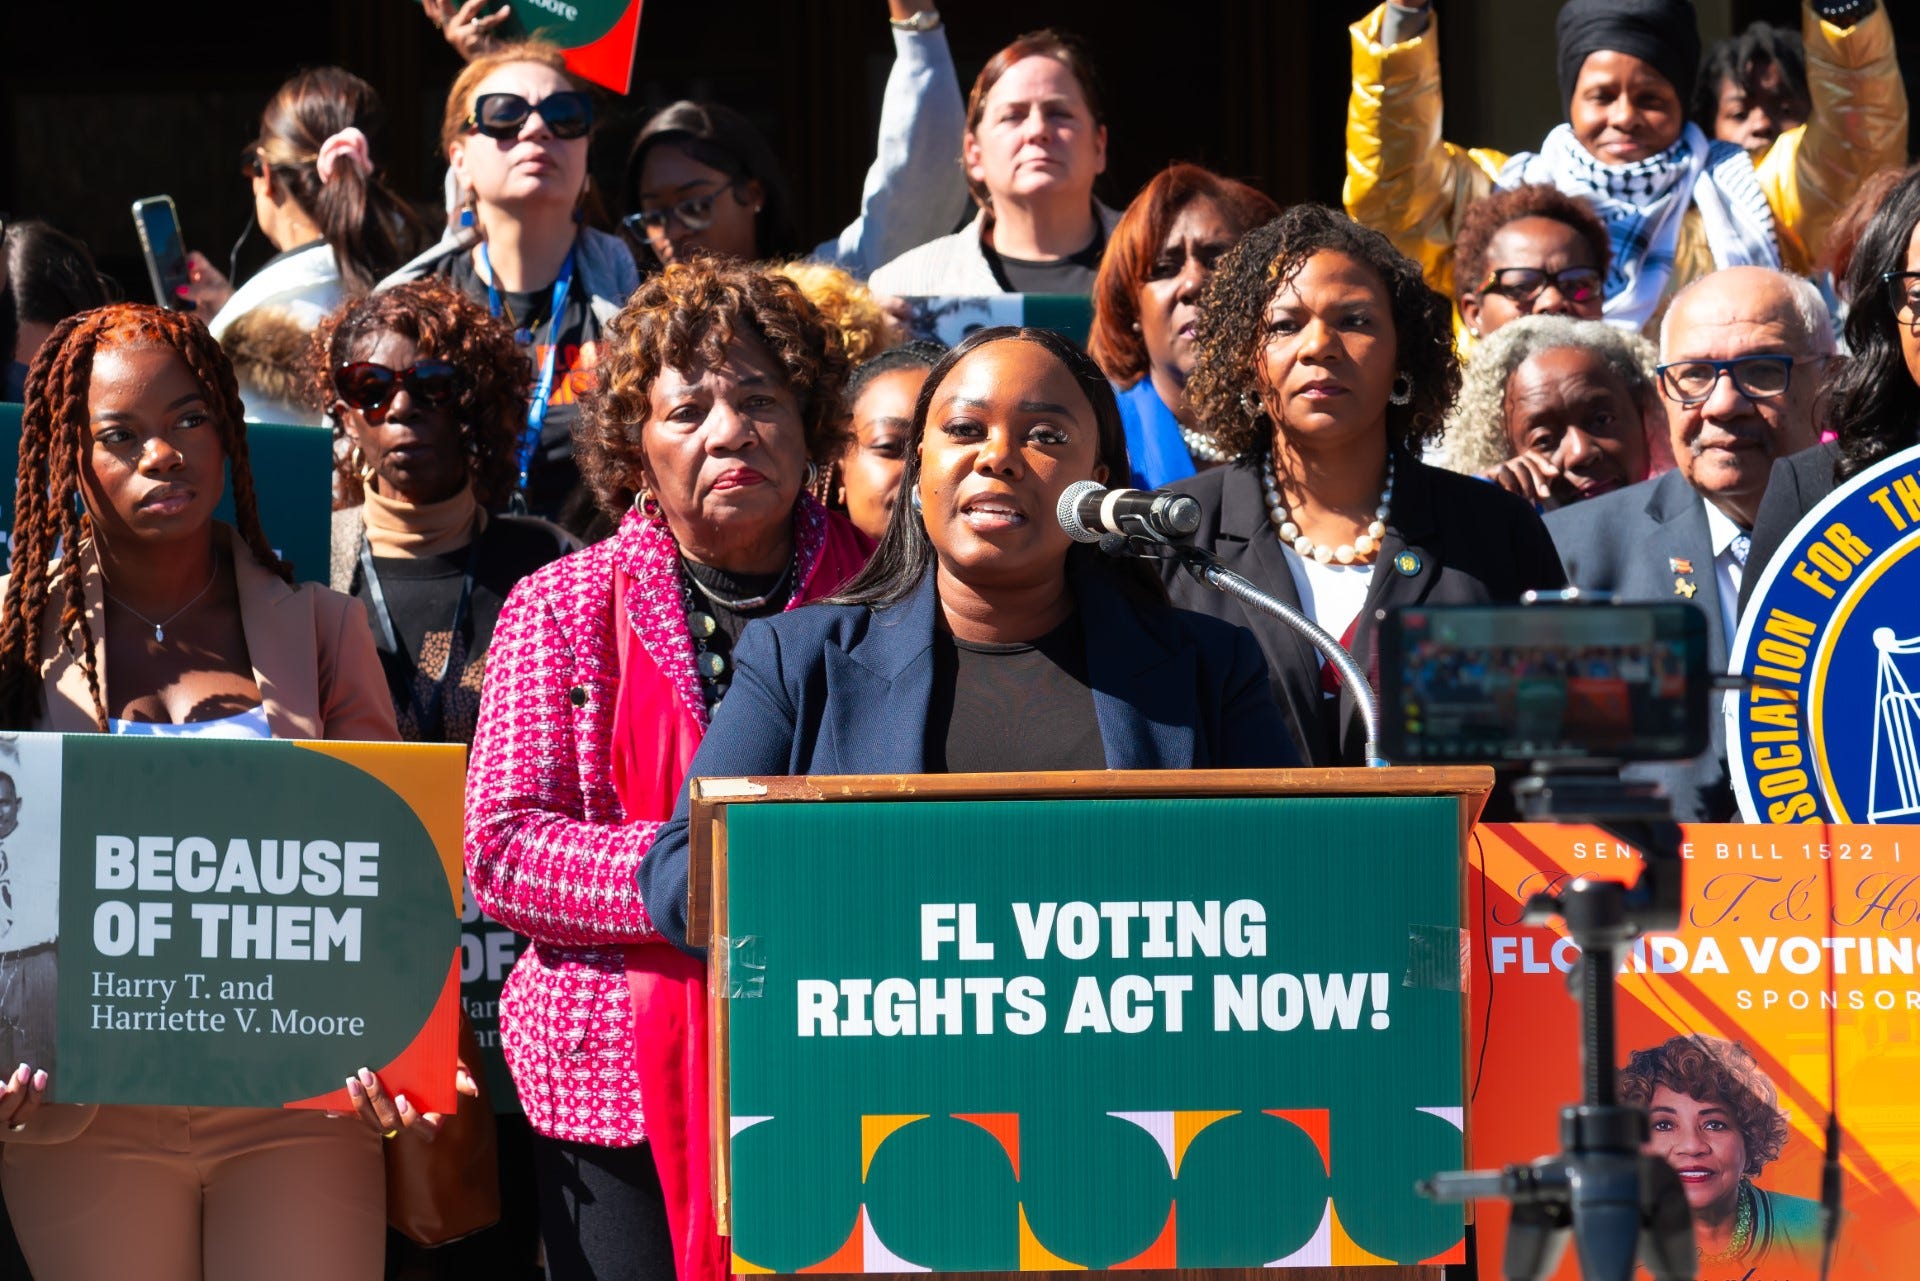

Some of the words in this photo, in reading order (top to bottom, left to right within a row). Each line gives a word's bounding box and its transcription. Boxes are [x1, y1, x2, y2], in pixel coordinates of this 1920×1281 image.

[528, 0, 578, 21] oore
[1750, 608, 1825, 824] SOCIATION
[1791, 522, 1873, 599] FOR
[1868, 470, 1920, 531] TH
[95, 835, 379, 896] BECAUSE
[1573, 842, 1695, 859] SENE
[1716, 843, 1783, 859] BILL
[1803, 843, 1874, 859] 1522
[1690, 872, 1782, 928] T.
[1769, 874, 1817, 921] &
[93, 900, 172, 957] OF
[191, 903, 362, 962] THEM
[921, 903, 994, 960] FL
[1012, 900, 1267, 960] VOTING
[1491, 936, 1730, 974] FLOIDA
[1731, 936, 1920, 975] VOTIN
[91, 972, 177, 1004] Harry
[185, 974, 211, 999] T.
[220, 975, 274, 1001] and
[797, 976, 1047, 1036] RIGHTS
[1064, 974, 1193, 1034] ACT
[1213, 973, 1390, 1032] NOW!
[1736, 989, 1920, 1010] SPONSOR
[90, 1004, 226, 1033] Harriette
[234, 1008, 261, 1033] V.
[270, 1009, 365, 1037] Moore
